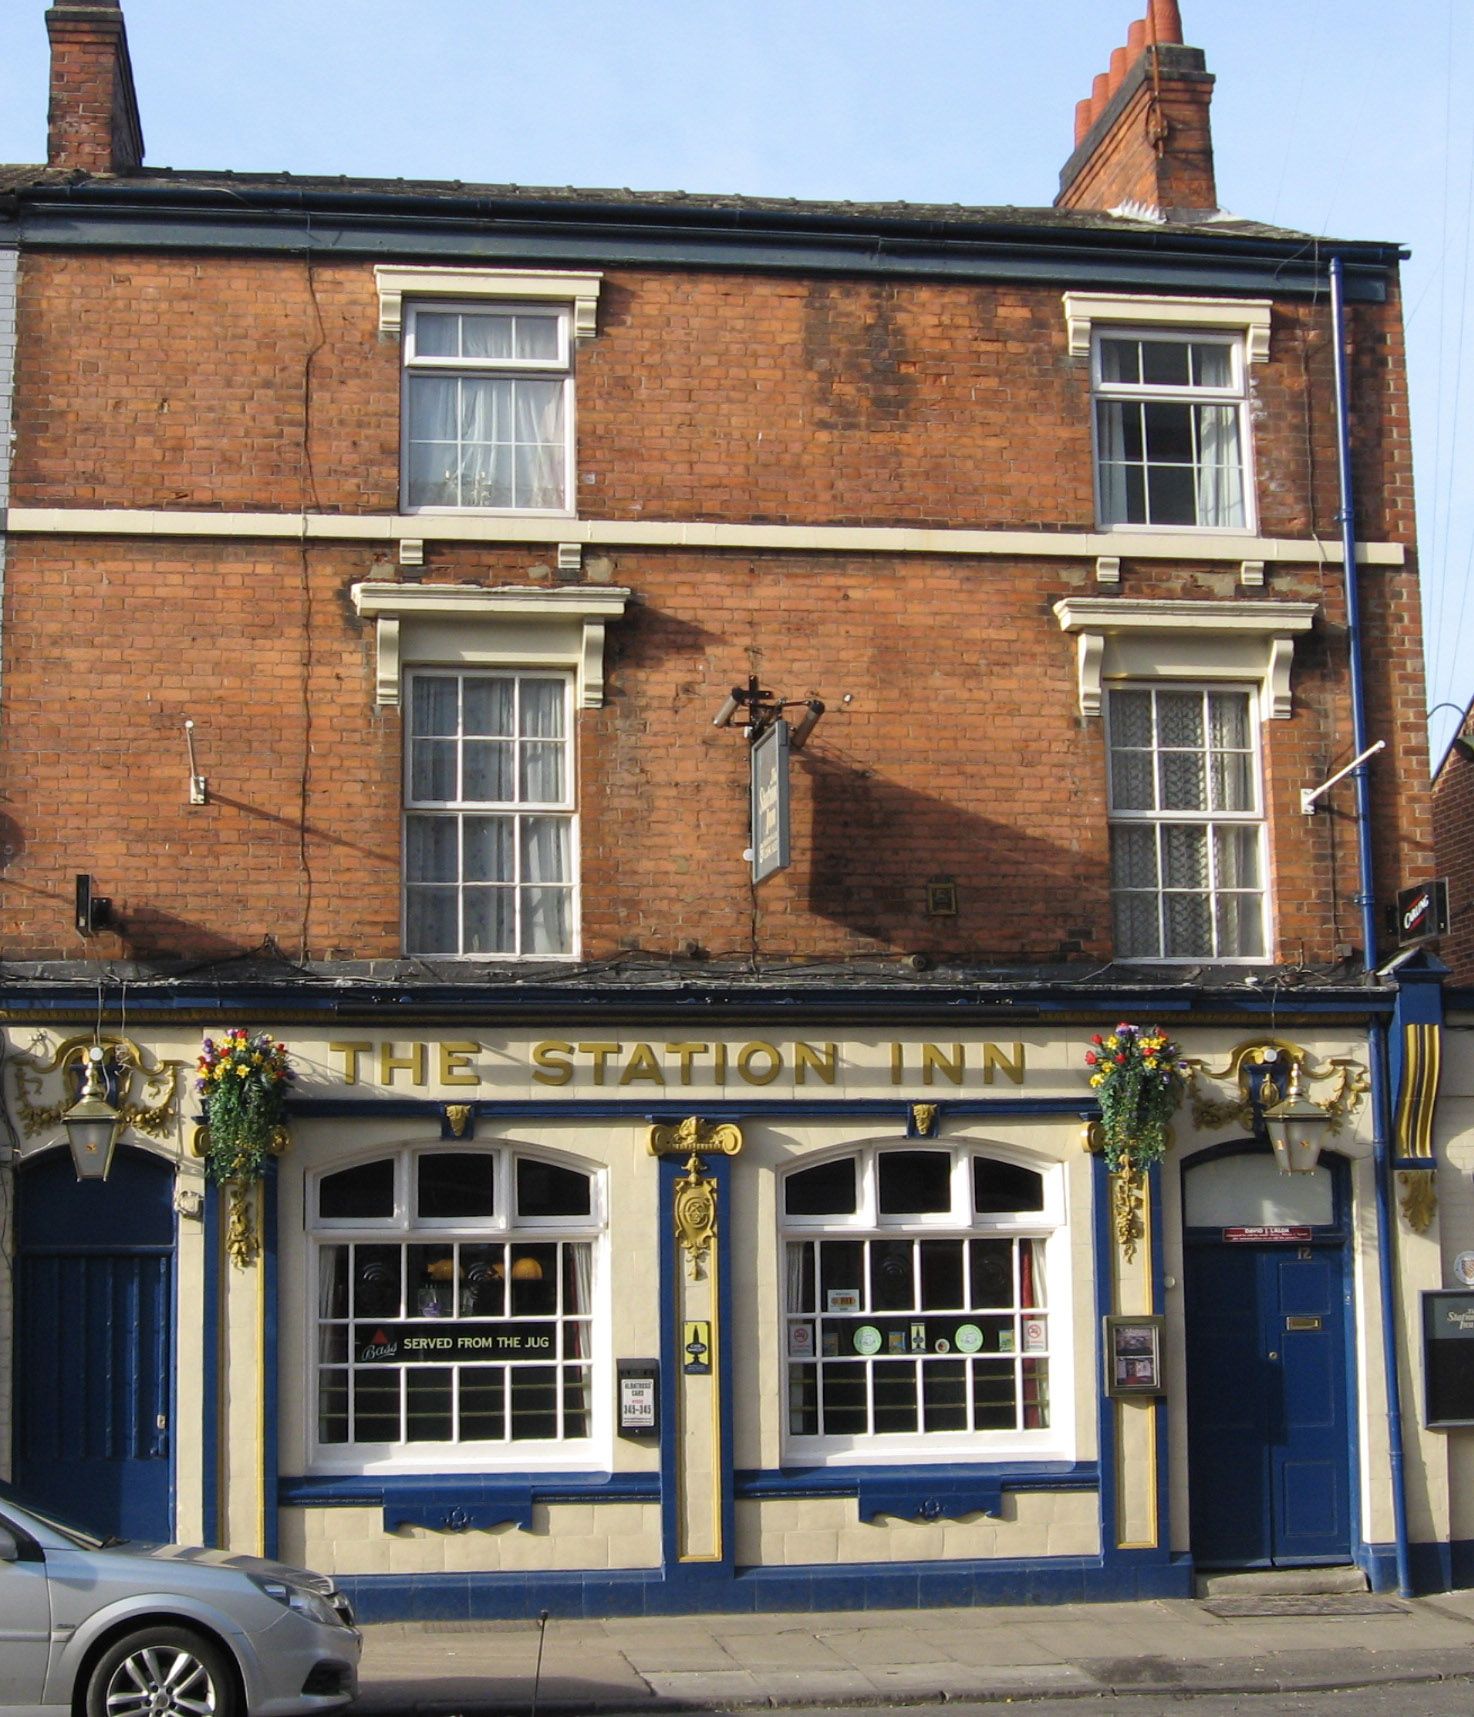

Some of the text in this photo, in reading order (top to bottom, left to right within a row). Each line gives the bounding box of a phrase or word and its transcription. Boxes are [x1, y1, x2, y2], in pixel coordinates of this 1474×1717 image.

[328, 1039, 1025, 1086] THE STATION INN
[1297, 1247, 1312, 1260] 12
[403, 1336, 549, 1350] SERVED FROM THE JUG
[362, 1342, 398, 1361] Bass
